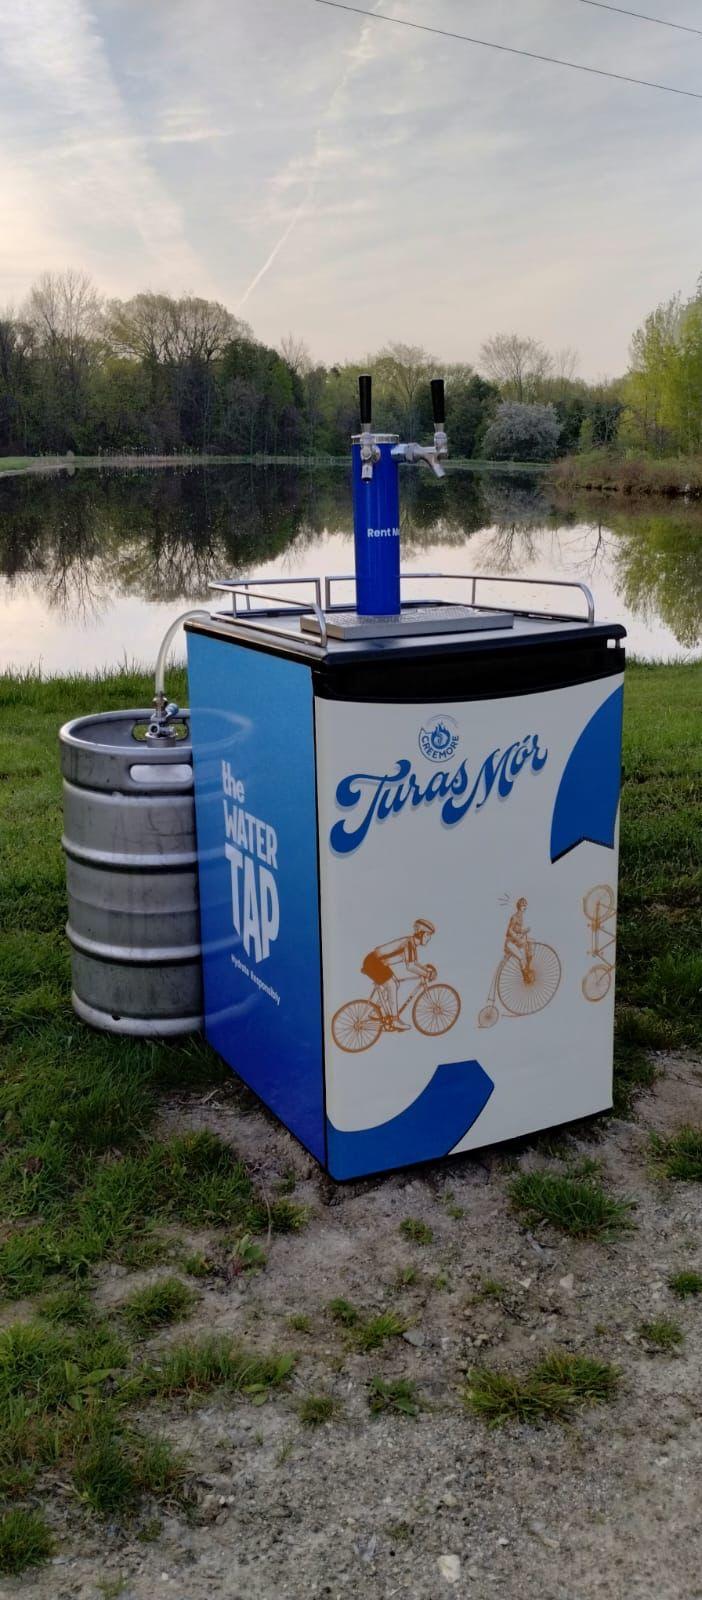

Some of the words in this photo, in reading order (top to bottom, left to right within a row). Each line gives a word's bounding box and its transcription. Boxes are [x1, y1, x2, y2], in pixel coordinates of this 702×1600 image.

[367, 527, 391, 538] Rent
[421, 735, 460, 760] CREEMORE
[222, 759, 245, 803] the
[329, 758, 469, 855] Turas
[441, 733, 549, 826] Mór
[223, 799, 278, 870] WATER
[225, 842, 280, 964] TAP
